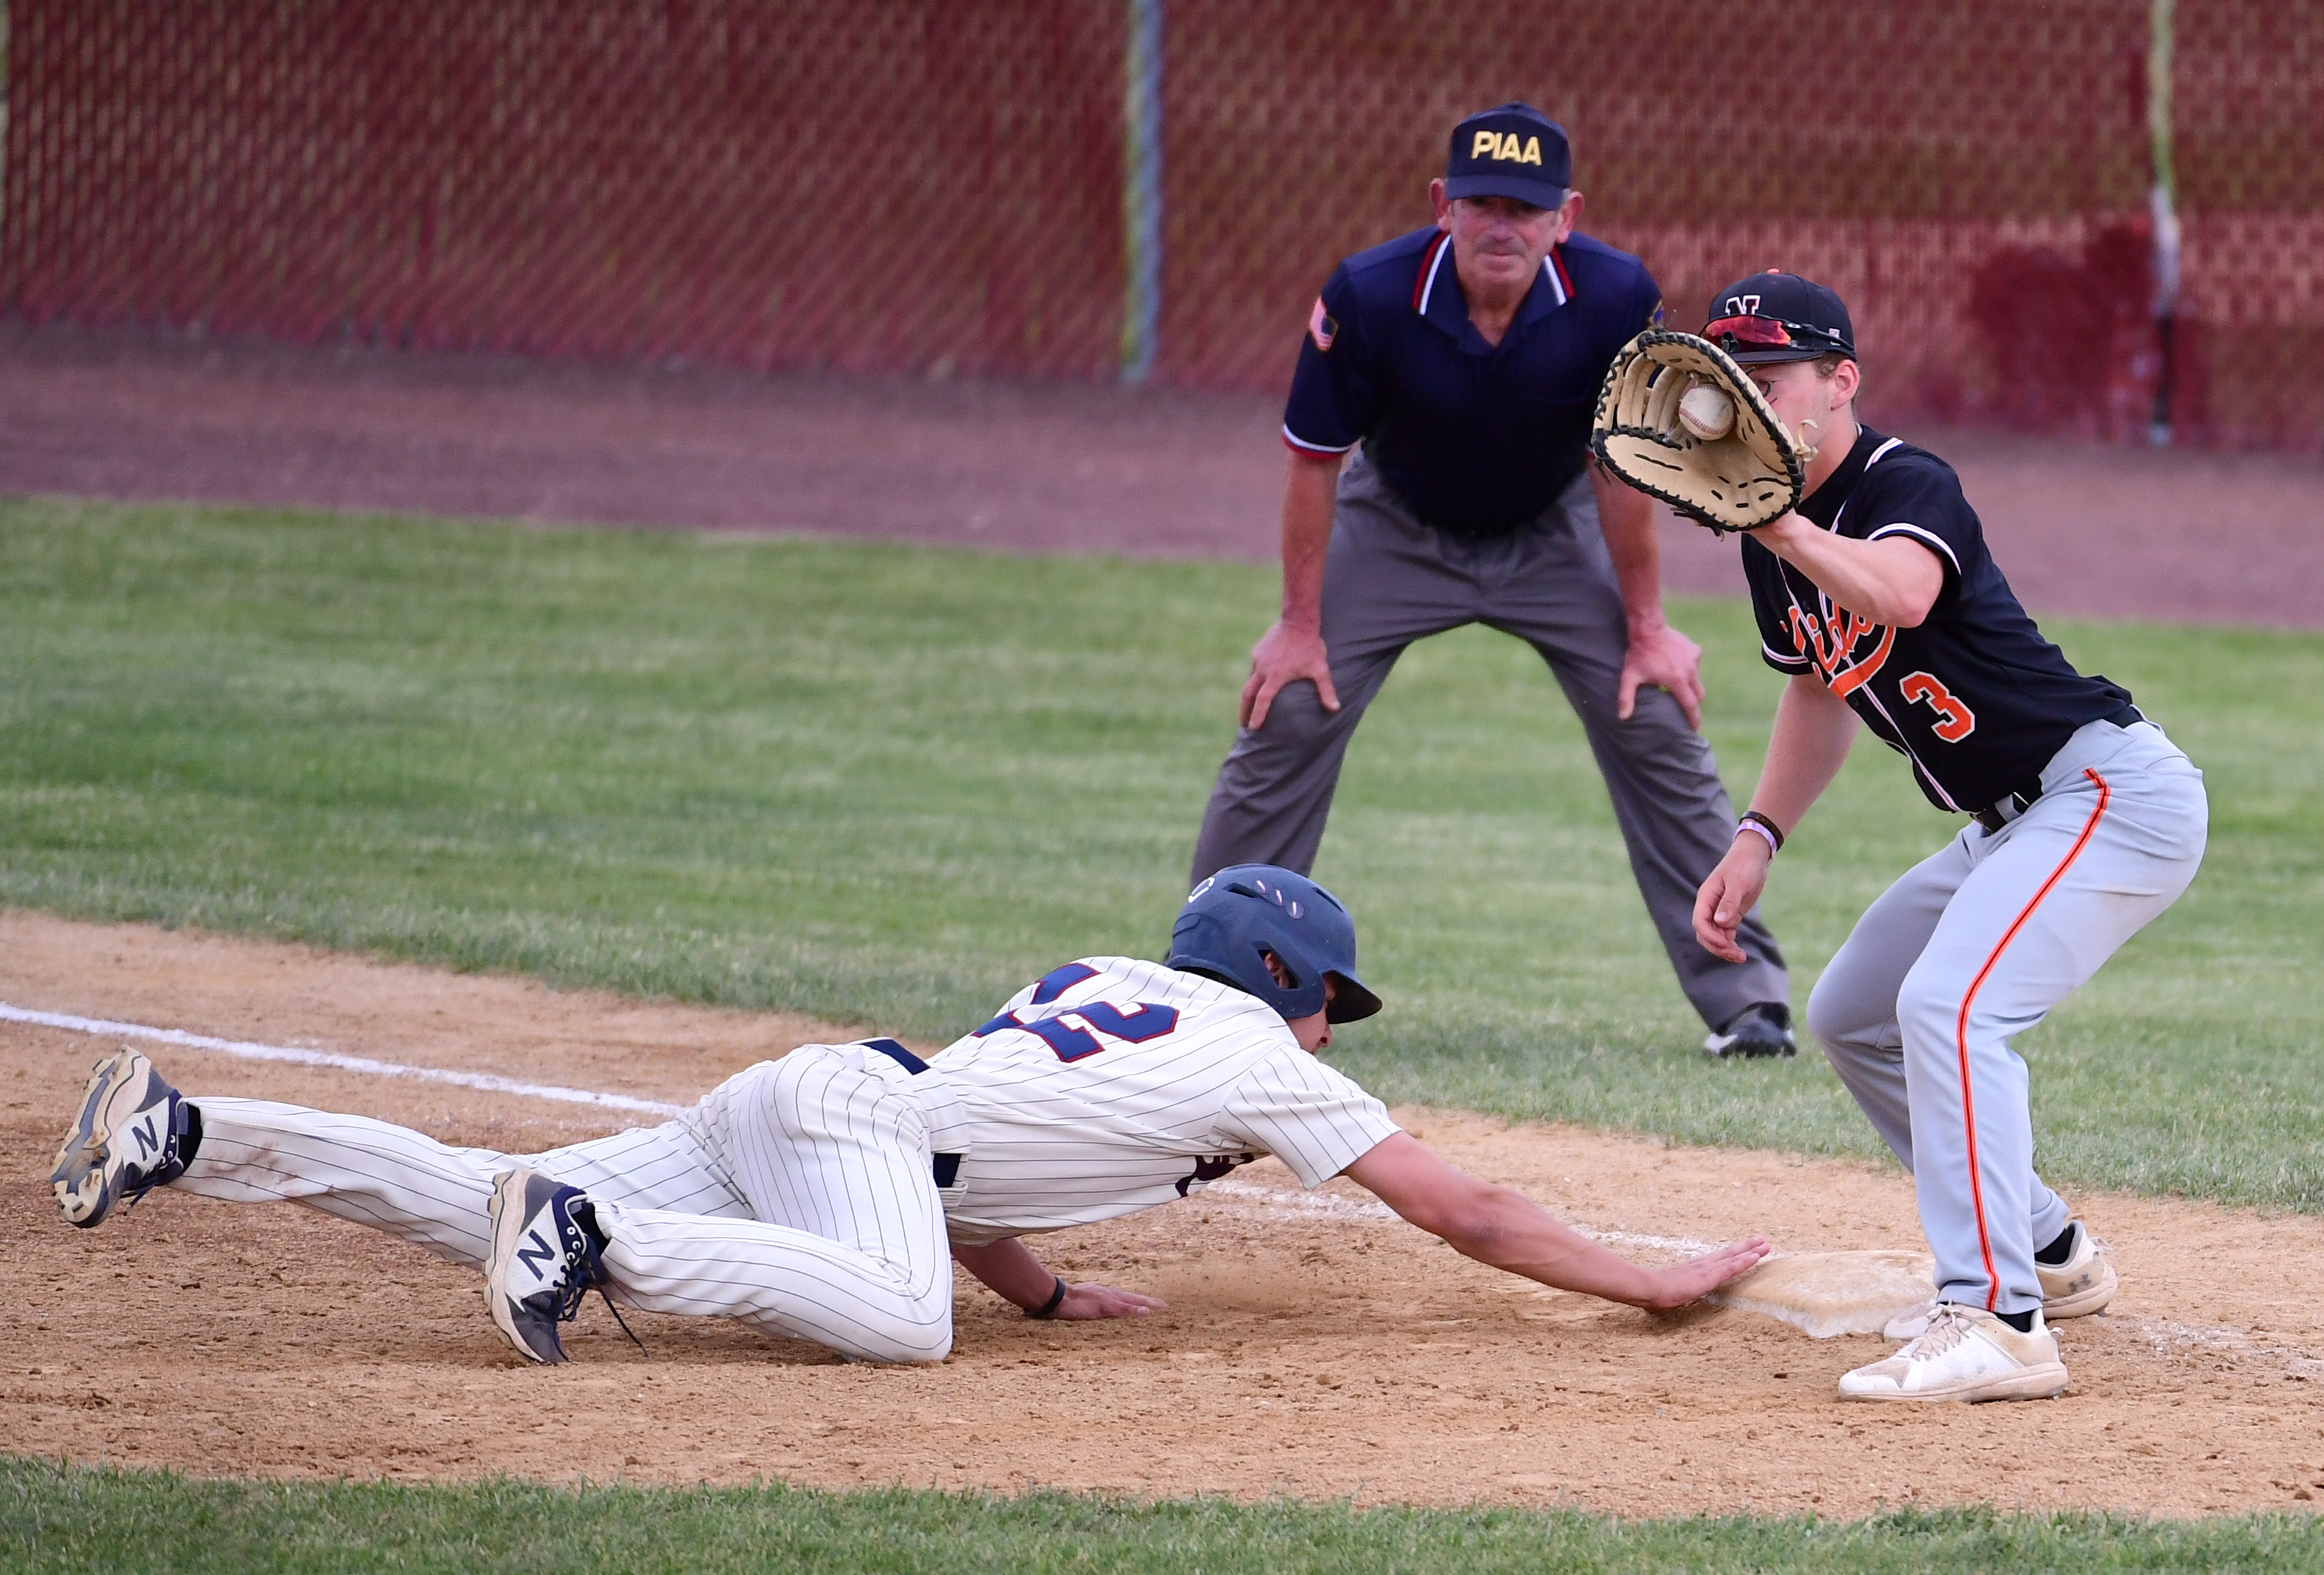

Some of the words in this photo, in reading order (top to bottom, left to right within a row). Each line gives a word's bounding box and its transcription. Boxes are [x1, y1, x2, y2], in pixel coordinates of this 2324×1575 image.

[1471, 131, 1542, 166] PIAA
[1899, 671, 1975, 743] 3
[131, 1115, 159, 1162] N
[516, 1229, 556, 1282] N
